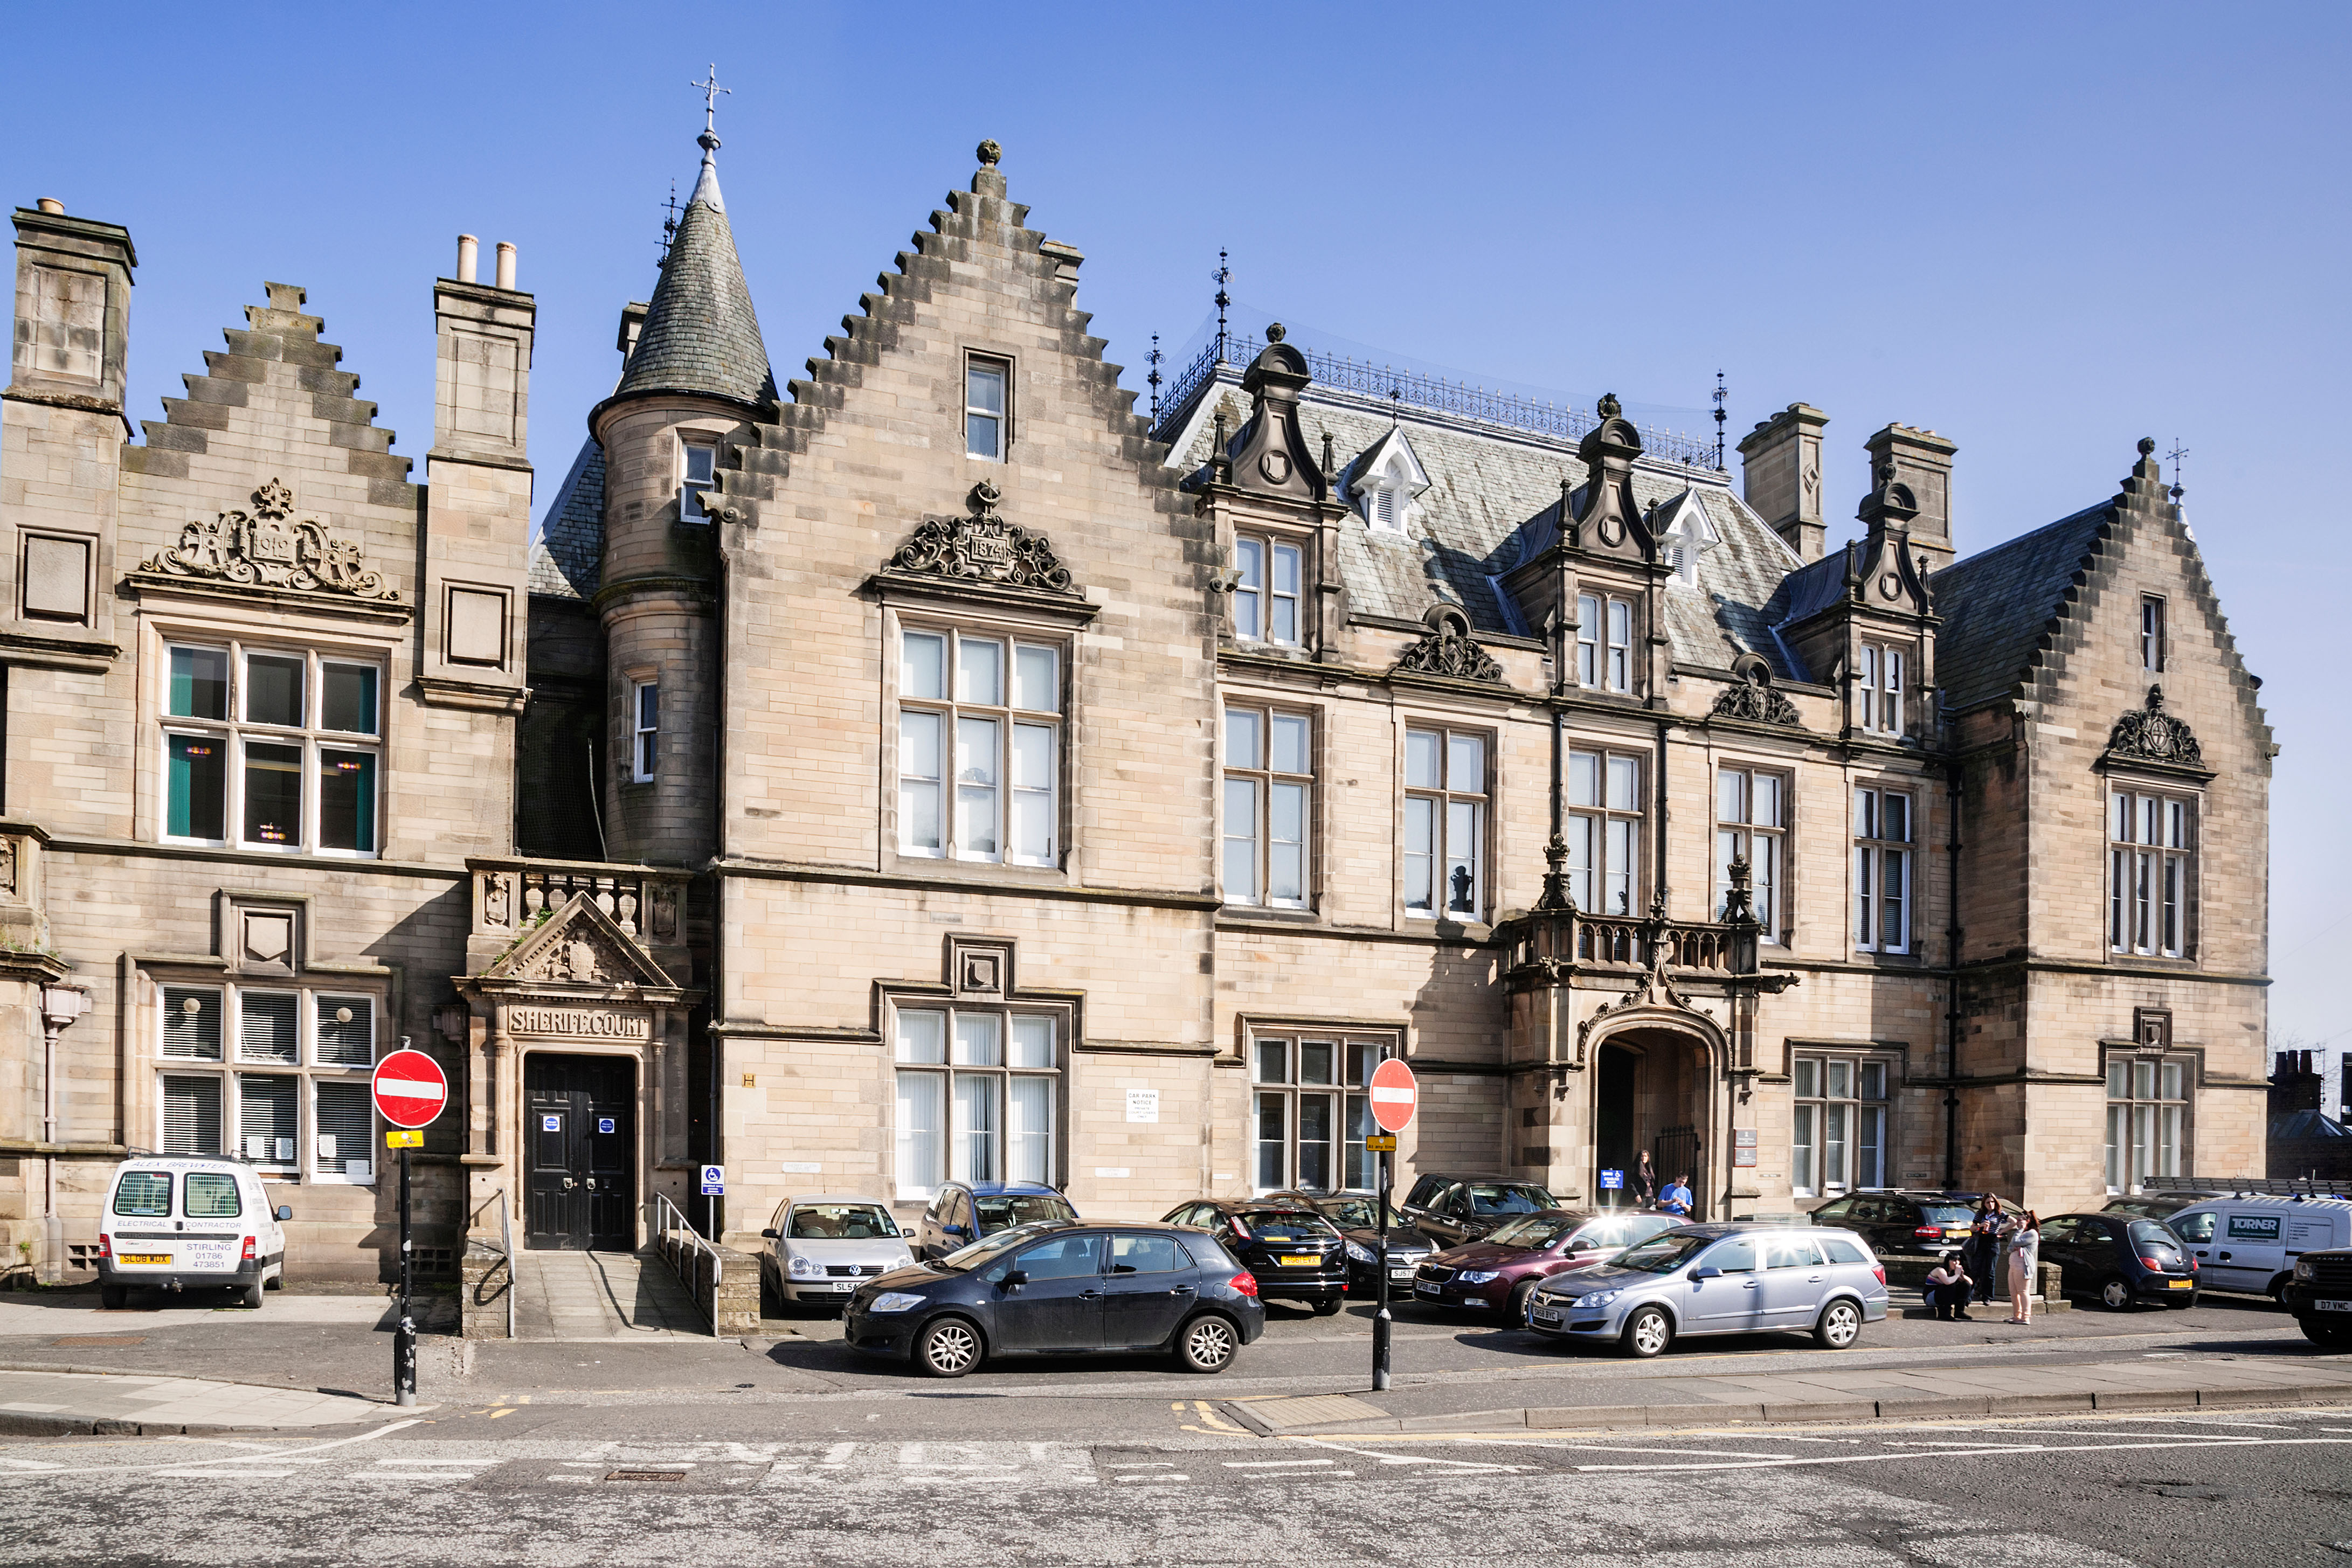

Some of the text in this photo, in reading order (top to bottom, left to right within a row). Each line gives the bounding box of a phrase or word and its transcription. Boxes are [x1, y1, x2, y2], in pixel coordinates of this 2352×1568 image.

[255, 535, 289, 558] 1912
[973, 540, 1005, 561] 1874
[511, 1009, 649, 1038] SHERIFF COURT
[2232, 1218, 2277, 1230] TURNER
[124, 1255, 147, 1263] SL08
[2321, 1301, 2330, 1309] D7
